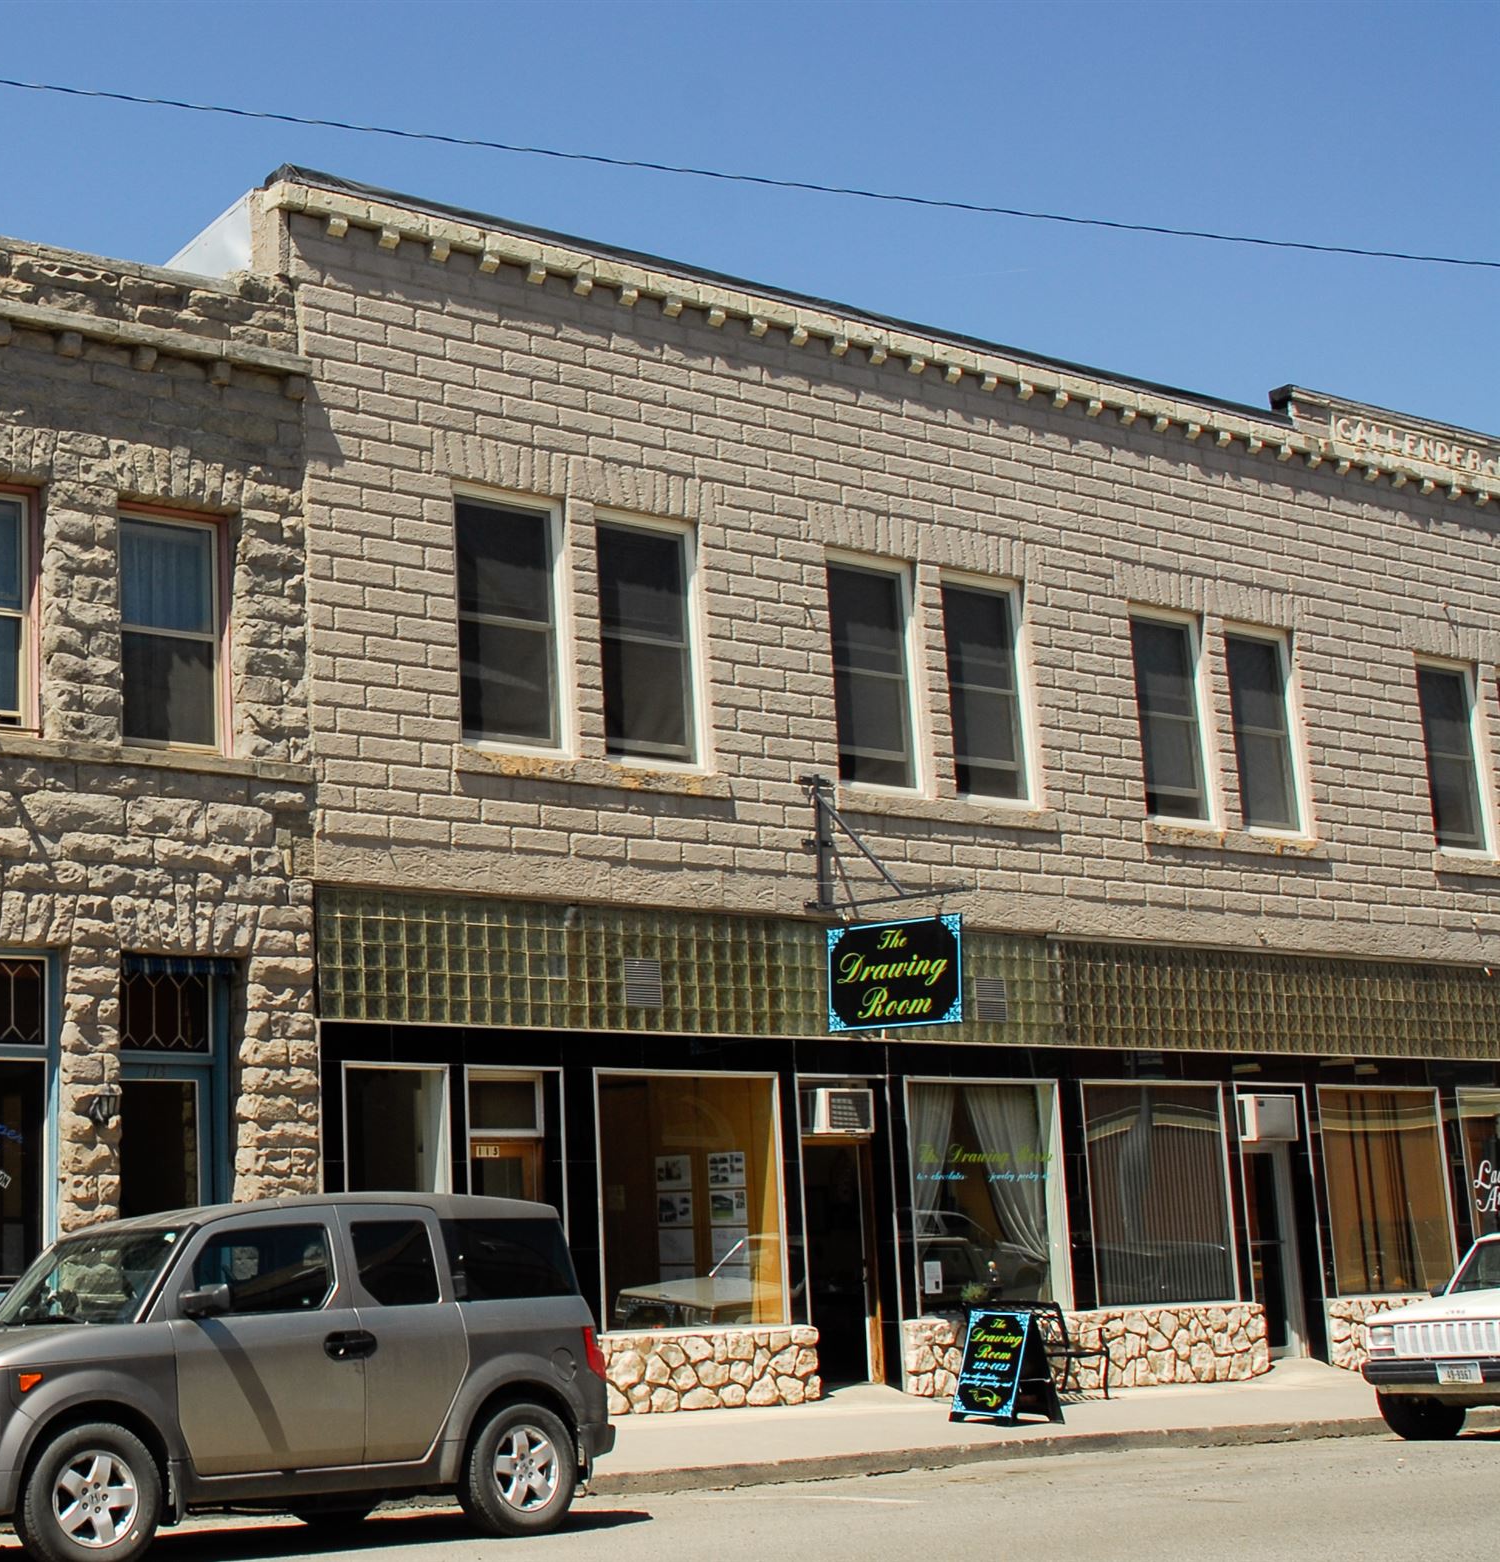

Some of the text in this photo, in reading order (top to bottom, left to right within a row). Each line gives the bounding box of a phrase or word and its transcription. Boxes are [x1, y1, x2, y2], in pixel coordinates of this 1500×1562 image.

[1335, 417, 1482, 472] CALLENDER
[877, 929, 908, 950] The
[836, 952, 948, 986] Drawing
[857, 986, 932, 1019] Room
[947, 1143, 1010, 1169] Drawing
[1473, 1160, 1500, 1189] La
[990, 1319, 1007, 1329] The
[970, 1327, 1024, 1349] Drawing
[974, 1344, 1012, 1360] Room
